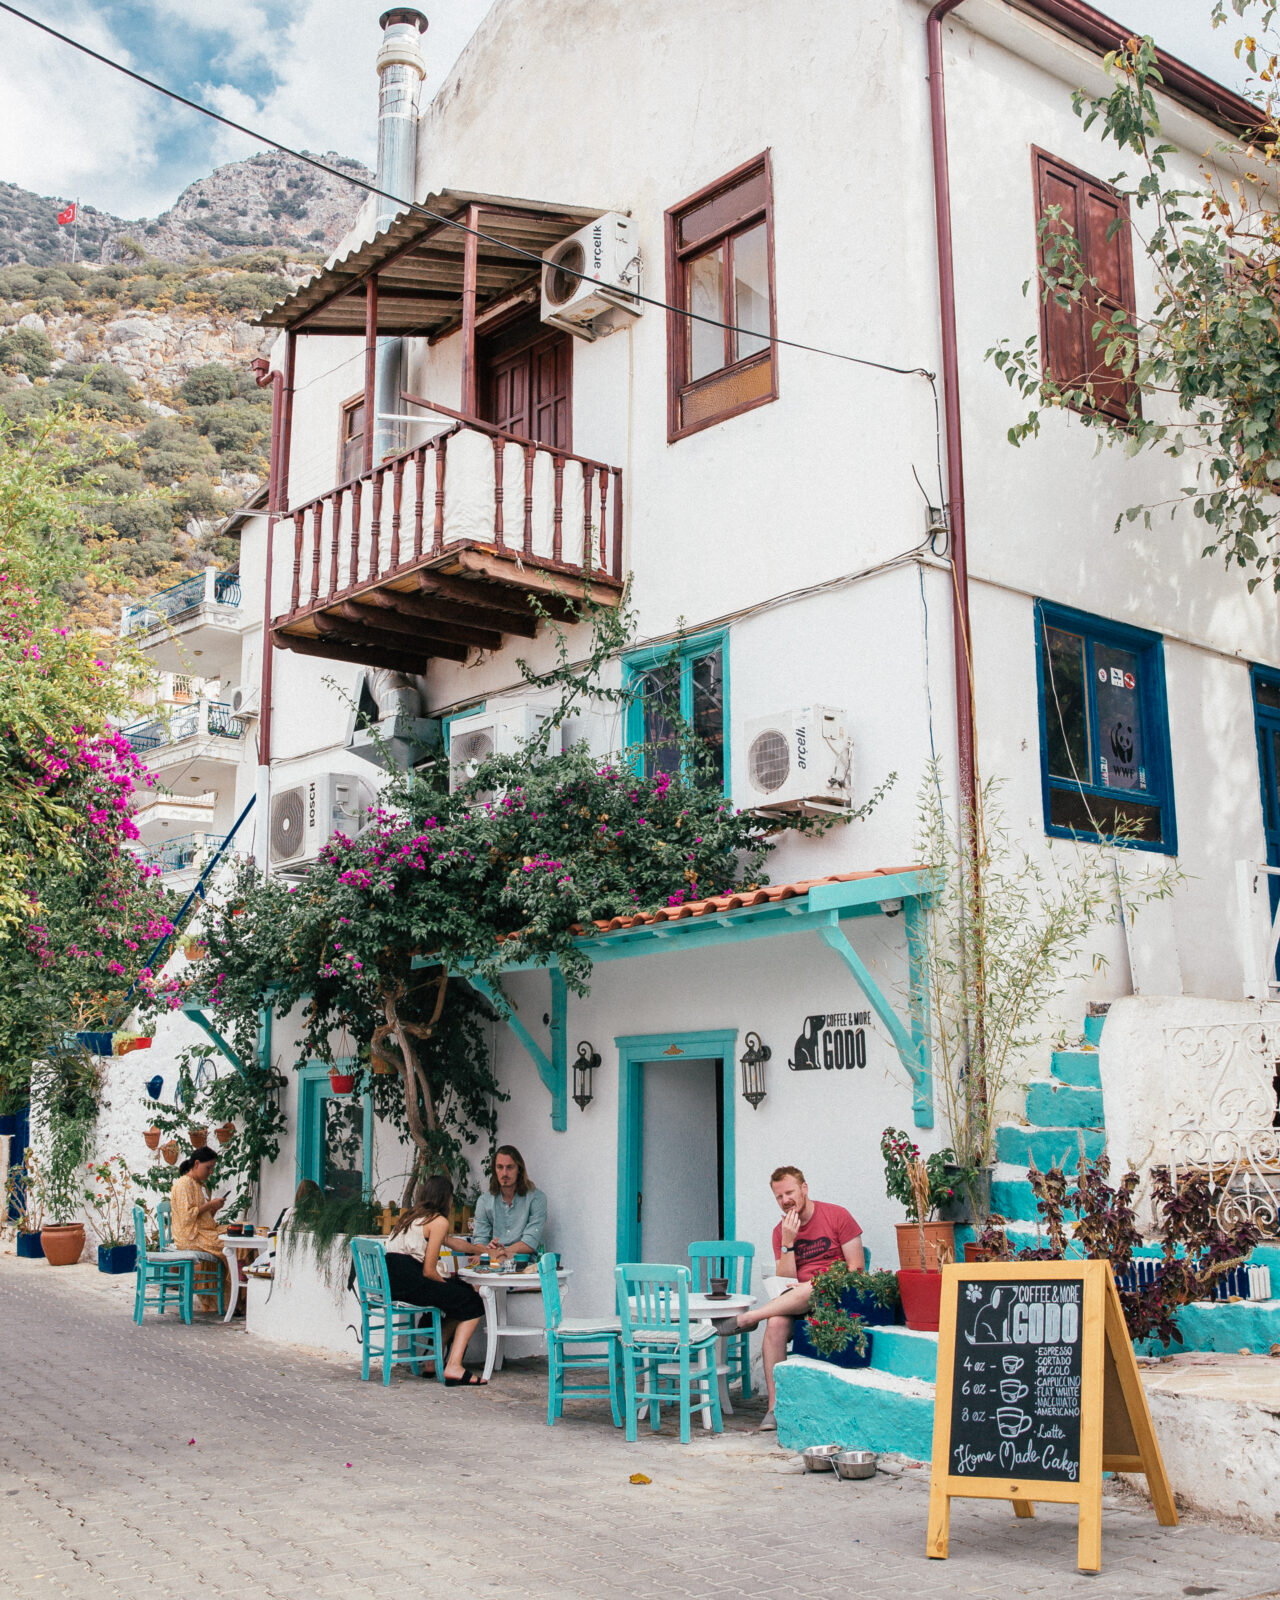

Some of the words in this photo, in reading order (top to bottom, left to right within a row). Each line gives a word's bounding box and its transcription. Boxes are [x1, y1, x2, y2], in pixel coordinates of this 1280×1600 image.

[593, 225, 603, 269] arçelik
[1112, 765, 1136, 779] WWF
[826, 1013, 847, 1027] COFFEE
[848, 1012, 853, 1026] &
[854, 1011, 871, 1025] MORE
[823, 1027, 866, 1070] GODO
[1019, 1285, 1052, 1302] COFFEE
[1051, 1285, 1059, 1303] &
[1059, 1285, 1081, 1303] MORE
[1012, 1302, 1079, 1344] GODO
[1038, 1346, 1073, 1356] ESPRESSO
[963, 1356, 973, 1371] 4
[1037, 1356, 1072, 1366] CORTADO
[1037, 1366, 1070, 1376] PICCOLO
[961, 1380, 971, 1395] 6
[1036, 1376, 1081, 1387] CAPPUCCINO
[1037, 1387, 1054, 1397] FLAT
[1055, 1387, 1080, 1397] WHITE
[1037, 1396, 1078, 1408] MACCHIATO
[961, 1407, 970, 1422] 8
[1036, 1407, 1080, 1418] AMERICANO
[1037, 1423, 1067, 1439] Latte
[953, 1443, 996, 1473] Home
[999, 1438, 1040, 1471] Made
[1041, 1444, 1079, 1480] Cakes
